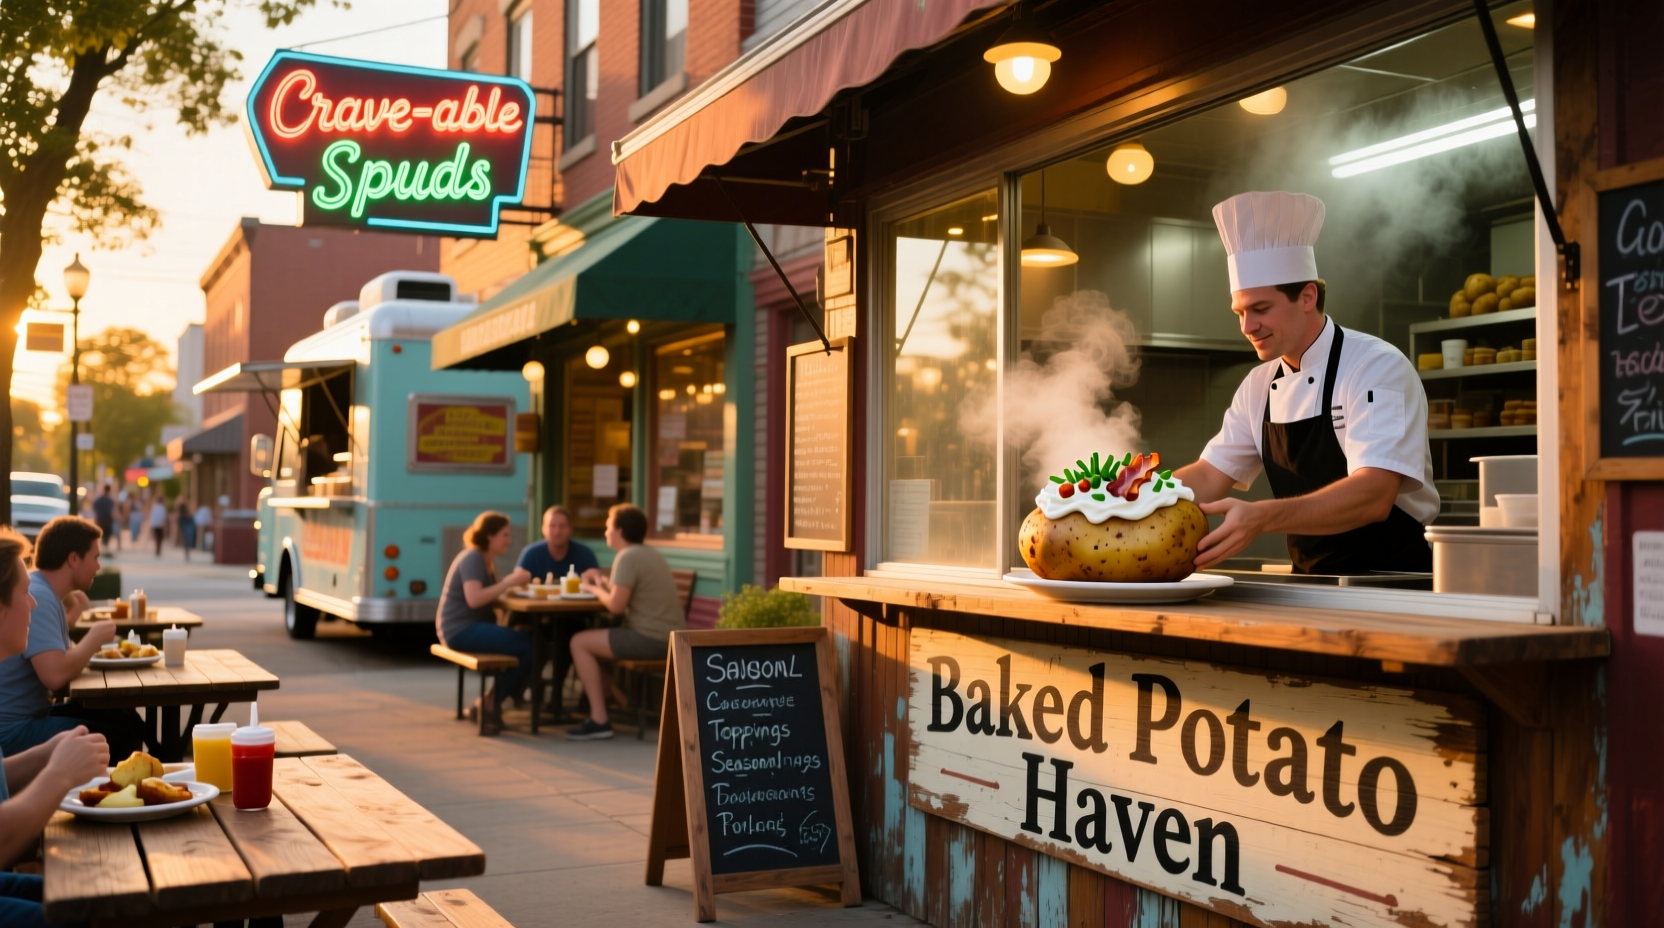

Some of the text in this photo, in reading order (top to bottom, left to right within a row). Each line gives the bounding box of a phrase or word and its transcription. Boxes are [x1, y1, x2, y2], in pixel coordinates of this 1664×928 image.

[269, 69, 523, 139] Crave-able
[312, 139, 492, 218] Spuds
[926, 653, 1419, 838] Baked Potato
[1020, 752, 1246, 897] Haven
